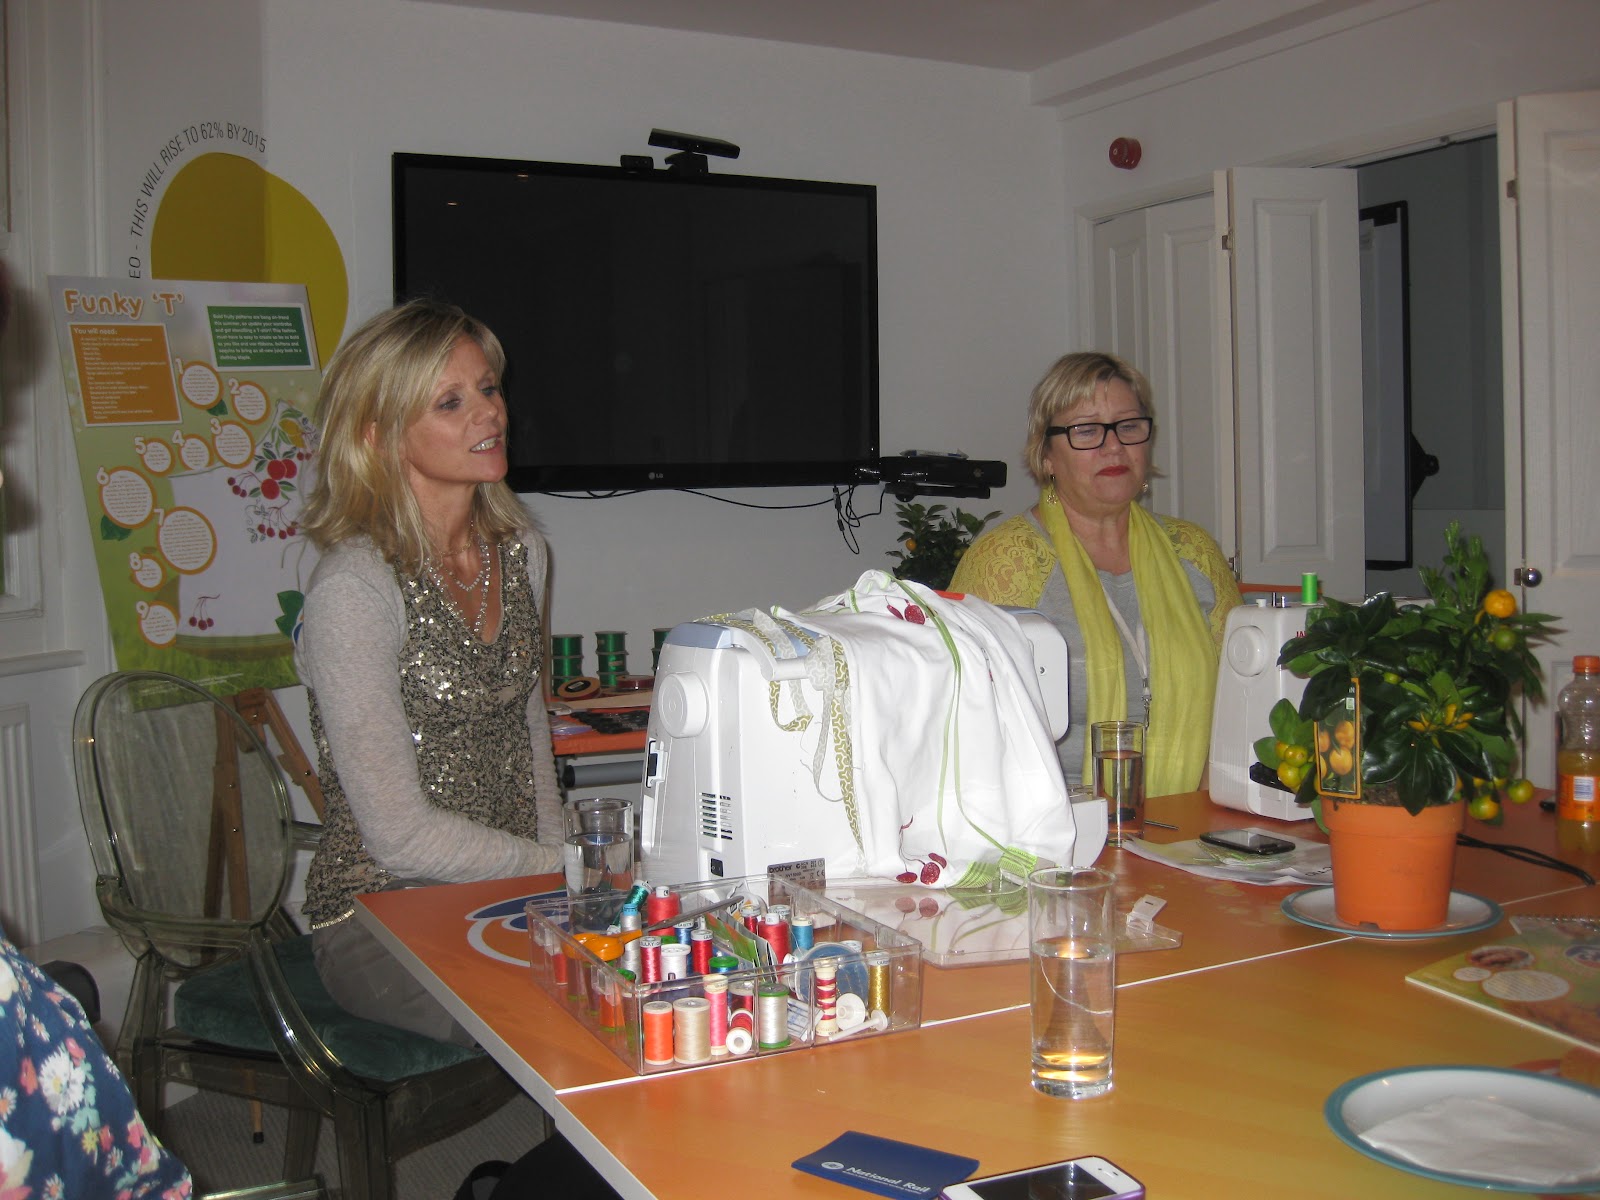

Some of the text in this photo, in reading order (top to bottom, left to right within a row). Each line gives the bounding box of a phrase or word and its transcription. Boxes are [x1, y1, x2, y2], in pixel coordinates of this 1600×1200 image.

[131, 198, 149, 237] THIS
[141, 162, 164, 197] WILL
[160, 134, 185, 166] RISE
[183, 126, 199, 146] TO
[201, 122, 224, 140] 62%
[227, 123, 240, 140] BY
[242, 127, 267, 153] 2015
[64, 289, 143, 318] Funky
[175, 358, 183, 374] 1
[228, 378, 240, 394] 2
[210, 418, 221, 435] 3
[134, 437, 146, 454] 5
[172, 430, 185, 446] 4
[97, 467, 110, 485] 6
[154, 508, 164, 526] 7
[129, 552, 142, 571] 8
[136, 601, 148, 619] 9
[768, 865, 792, 873] brother
[846, 1167, 902, 1185] National
[903, 1182, 930, 1193] Rail
